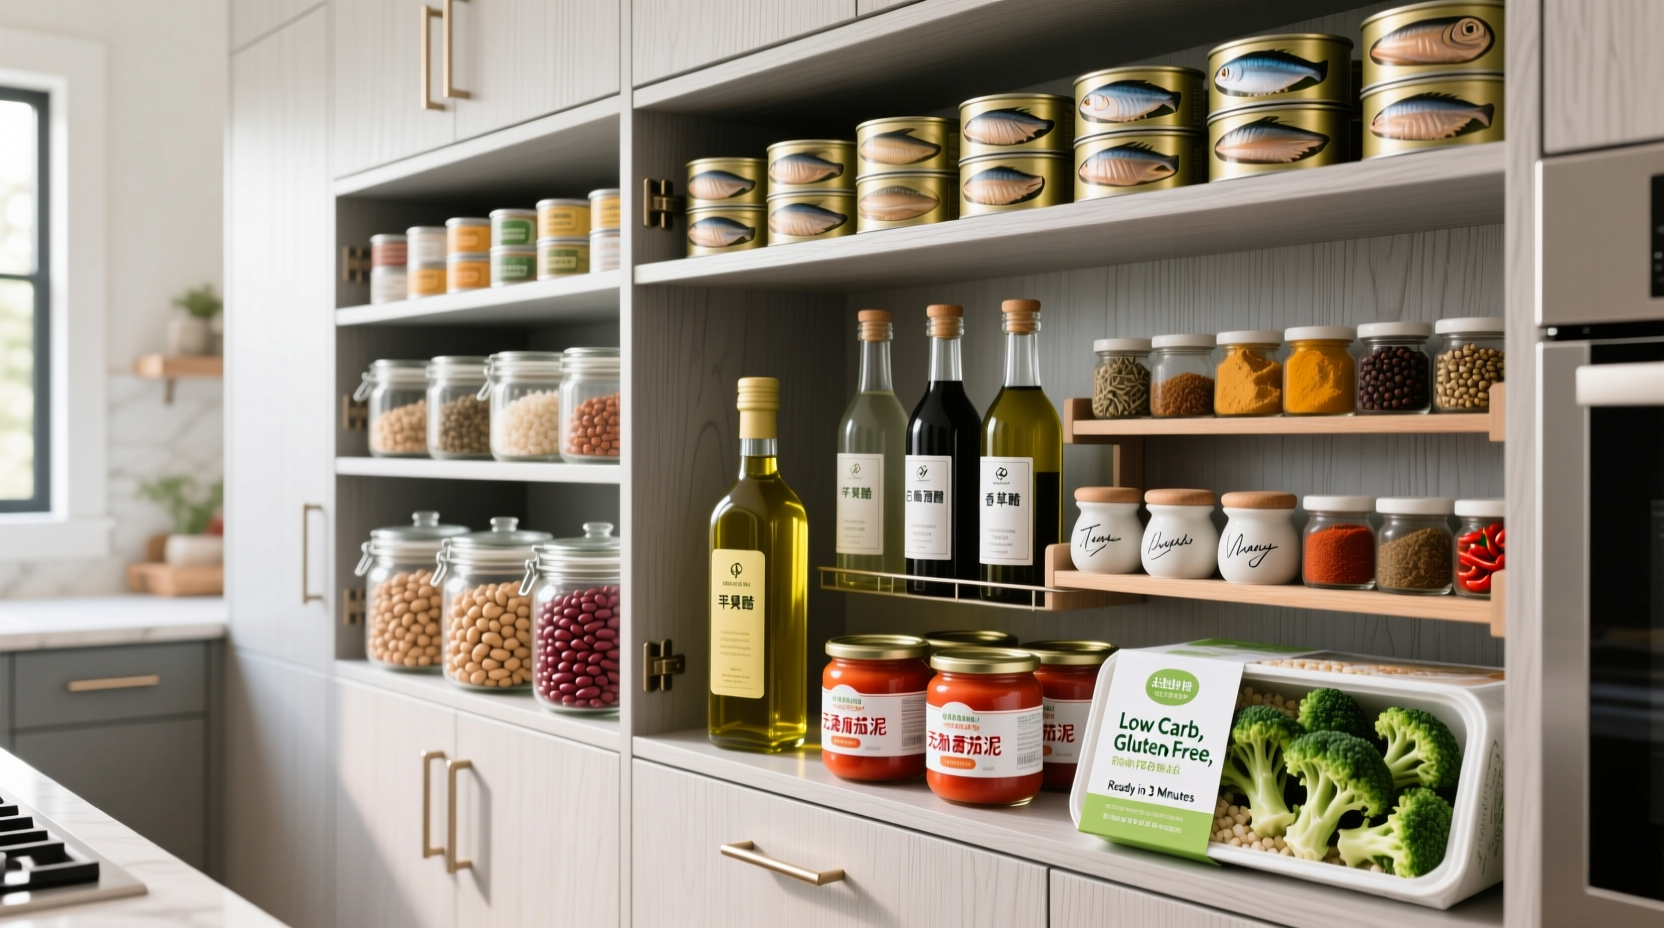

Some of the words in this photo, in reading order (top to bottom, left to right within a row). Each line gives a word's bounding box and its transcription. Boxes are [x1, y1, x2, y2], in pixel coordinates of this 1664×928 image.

[1119, 711, 1155, 733] Low
[1158, 716, 1204, 743] Carb,
[1114, 733, 1169, 758] Gluten
[1172, 740, 1213, 768] Free,
[1107, 779, 1136, 797] Ready
[1137, 783, 1146, 796] in
[1148, 785, 1155, 797] 3
